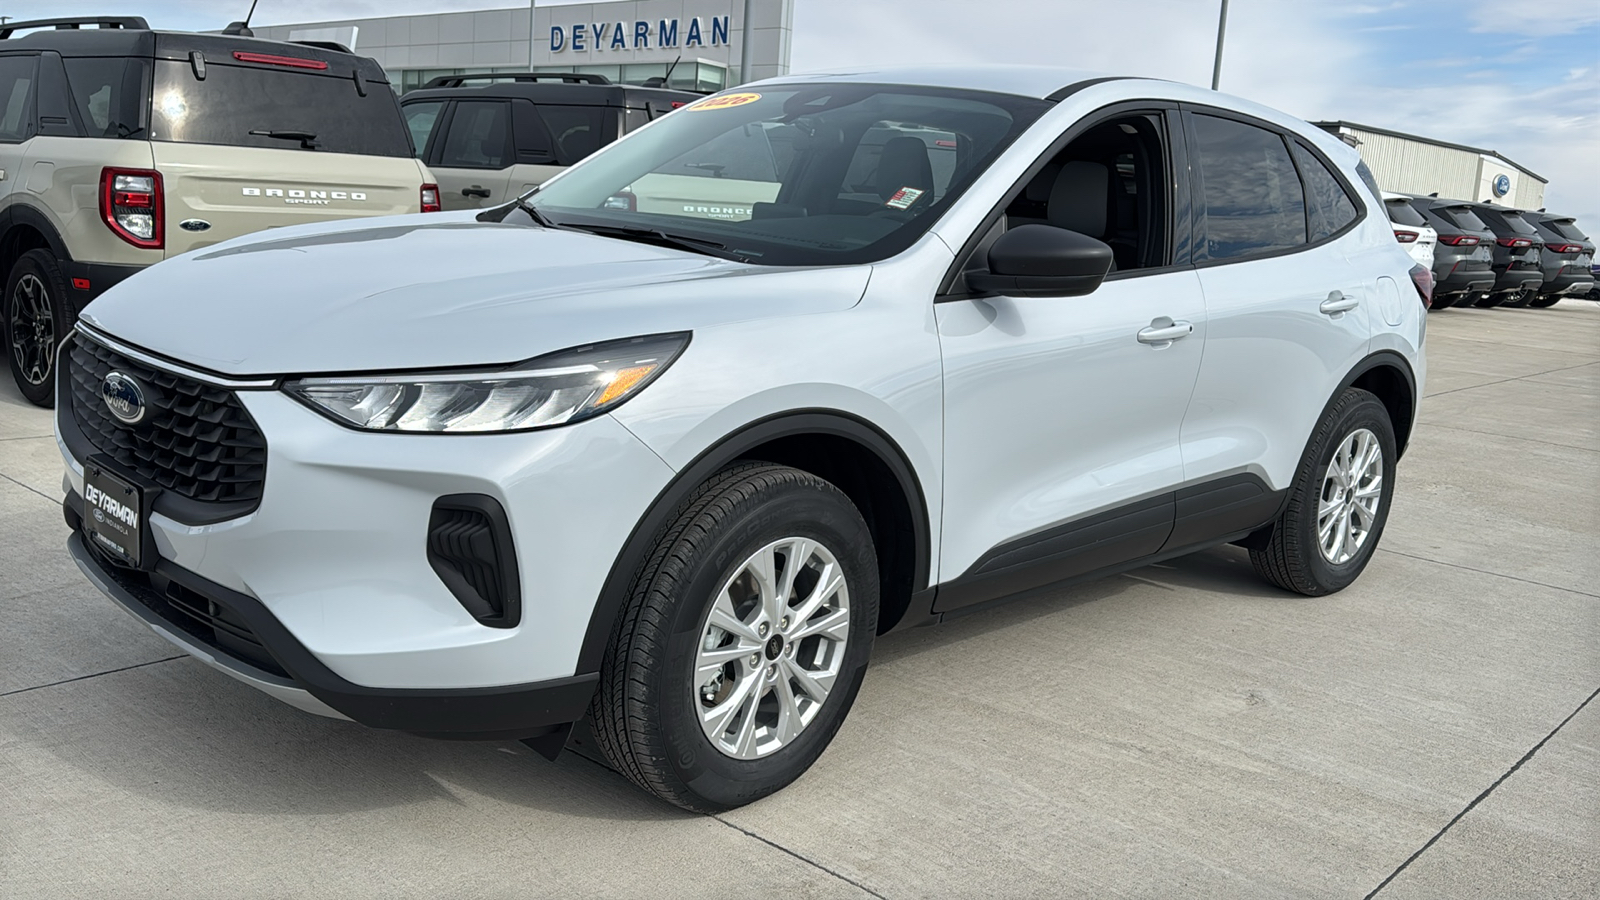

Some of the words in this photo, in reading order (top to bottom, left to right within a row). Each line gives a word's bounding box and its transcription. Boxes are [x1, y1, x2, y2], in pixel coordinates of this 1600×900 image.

[550, 16, 730, 51] DEYARMAN
[242, 187, 367, 200] BRONCO
[85, 483, 138, 529] DEYARMAN
